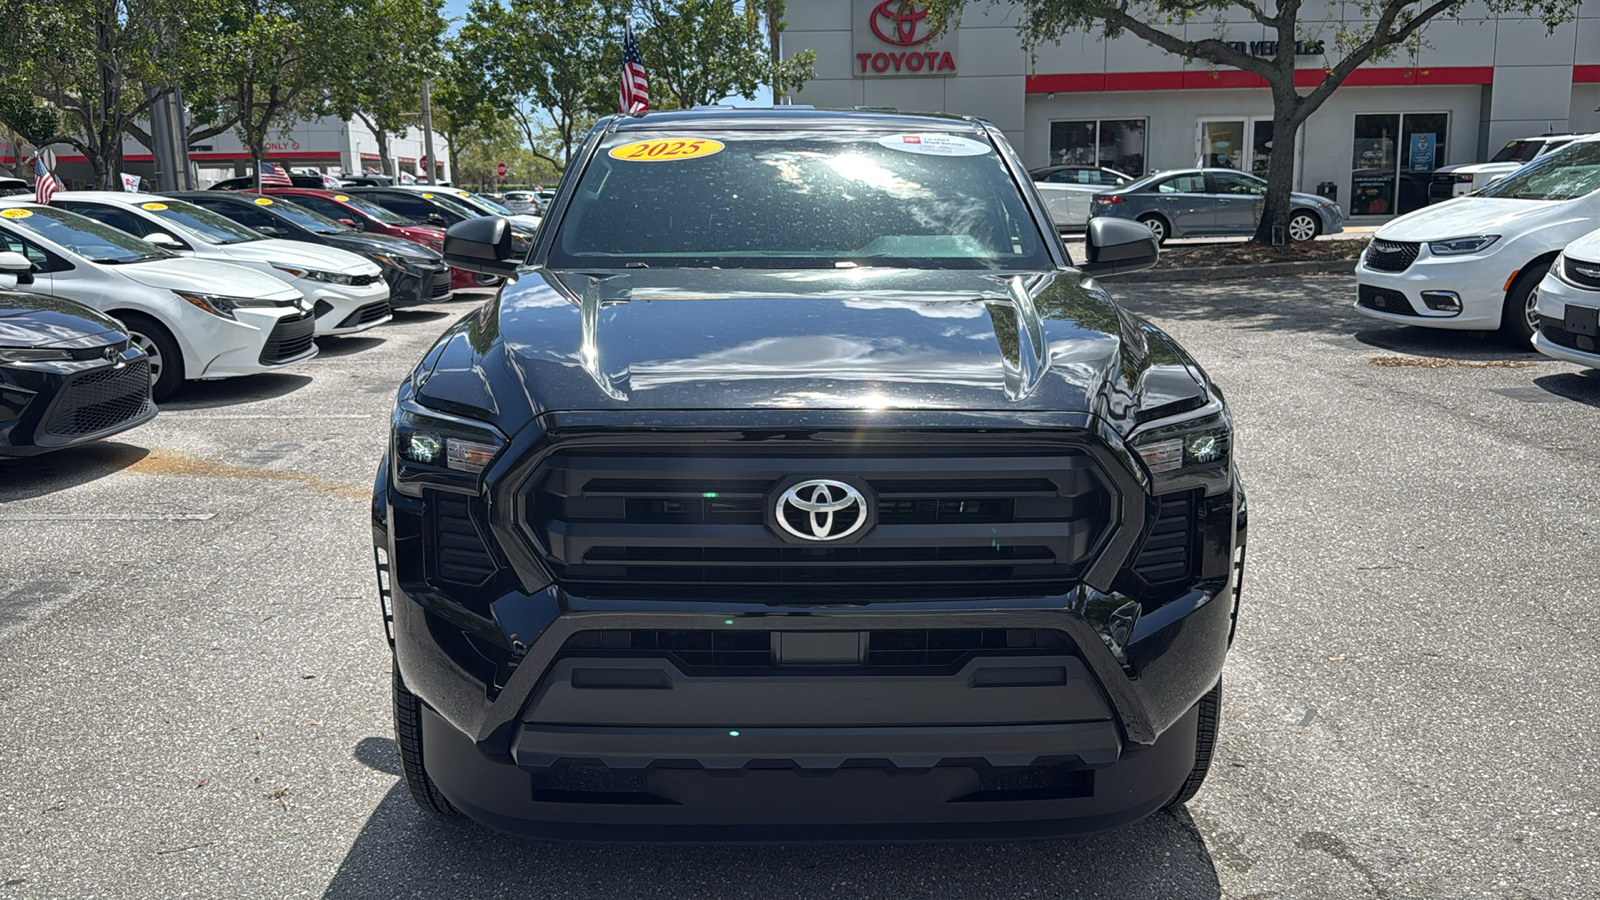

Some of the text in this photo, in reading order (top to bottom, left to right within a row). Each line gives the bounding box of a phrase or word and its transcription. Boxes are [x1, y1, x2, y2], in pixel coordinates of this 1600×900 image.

[856, 51, 956, 73] TOYOTA
[264, 142, 289, 150] ONLY
[627, 141, 706, 158] 2025
